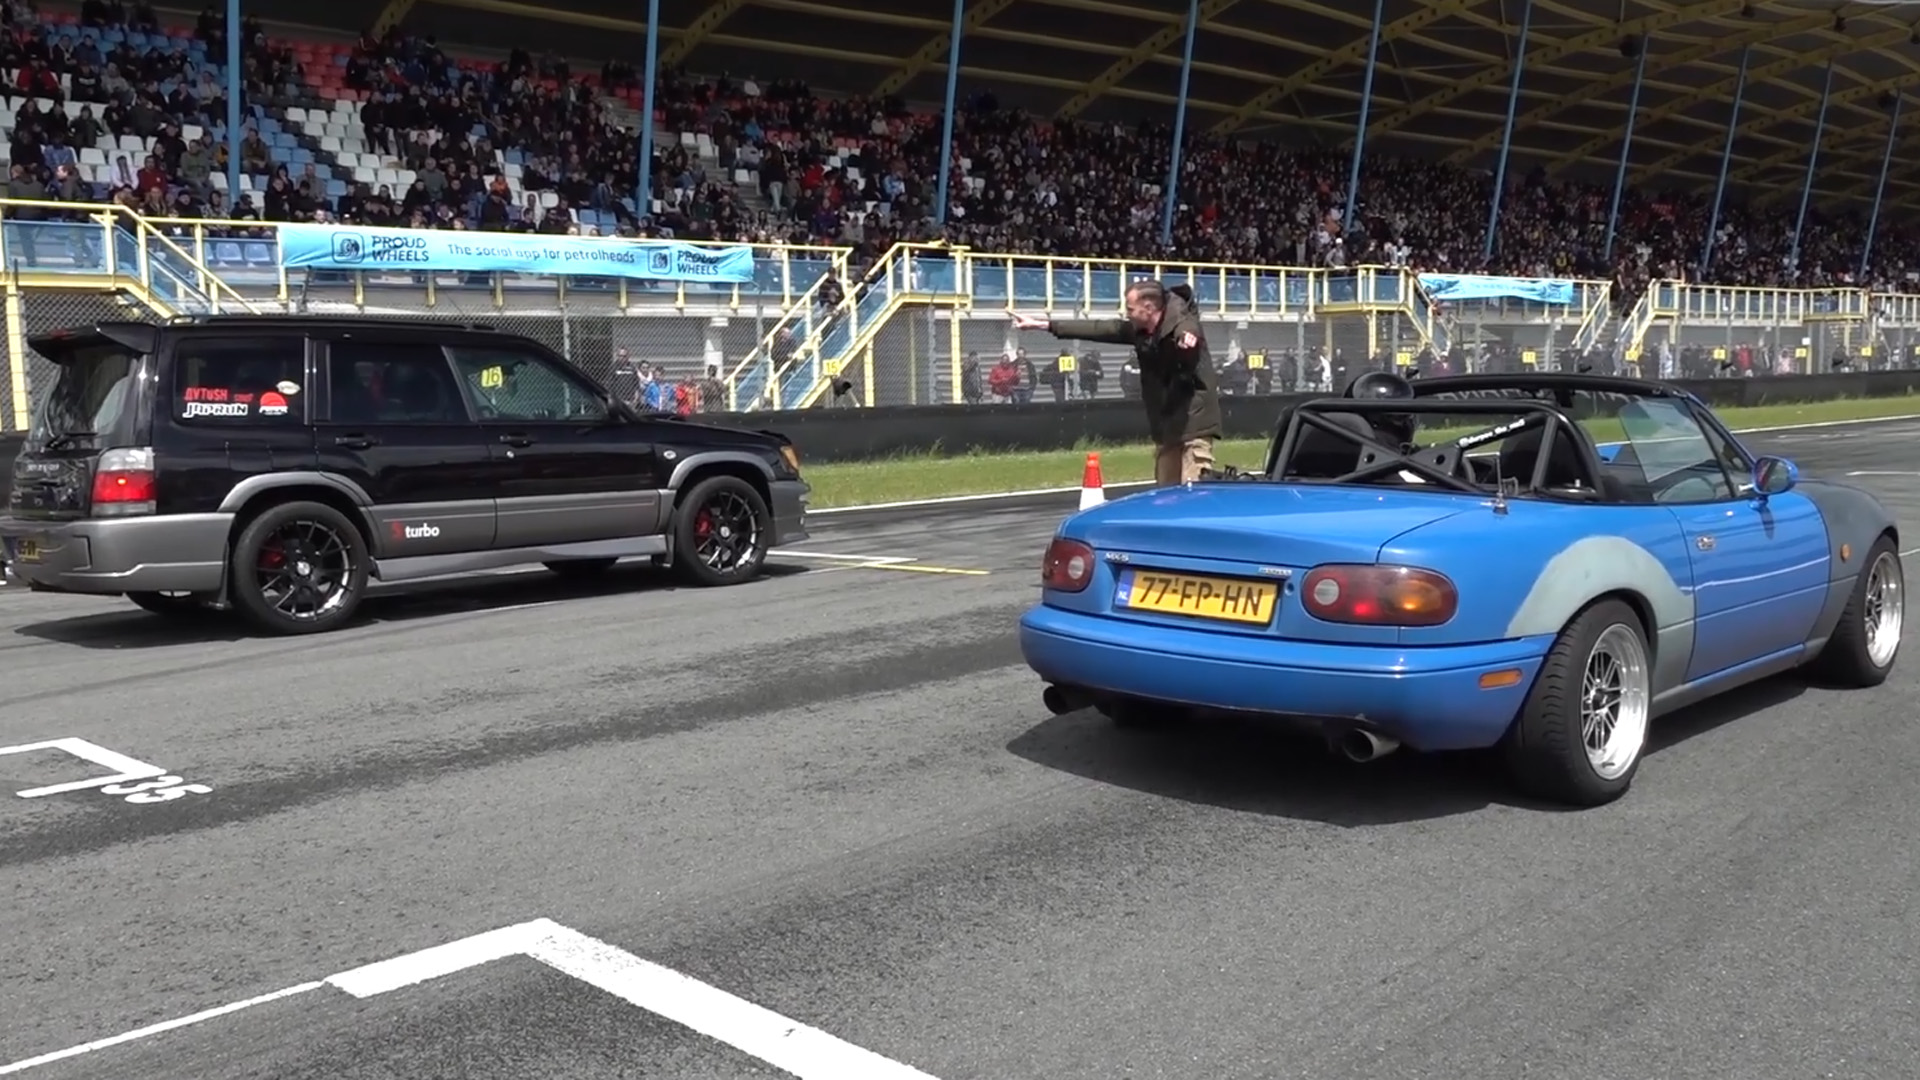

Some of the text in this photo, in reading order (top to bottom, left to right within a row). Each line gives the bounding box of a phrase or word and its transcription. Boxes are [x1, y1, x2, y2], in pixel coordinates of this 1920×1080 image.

[371, 235, 427, 249] PROUD
[371, 249, 430, 262] WHEELS
[448, 244, 635, 264] The social app for petrolheads
[677, 263, 719, 275] WHEELS
[485, 368, 500, 385] 16
[405, 522, 440, 538] turbo
[1117, 591, 1128, 600] NL
[1139, 576, 1263, 616] 77-FP-HN
[101, 775, 213, 803] 35
